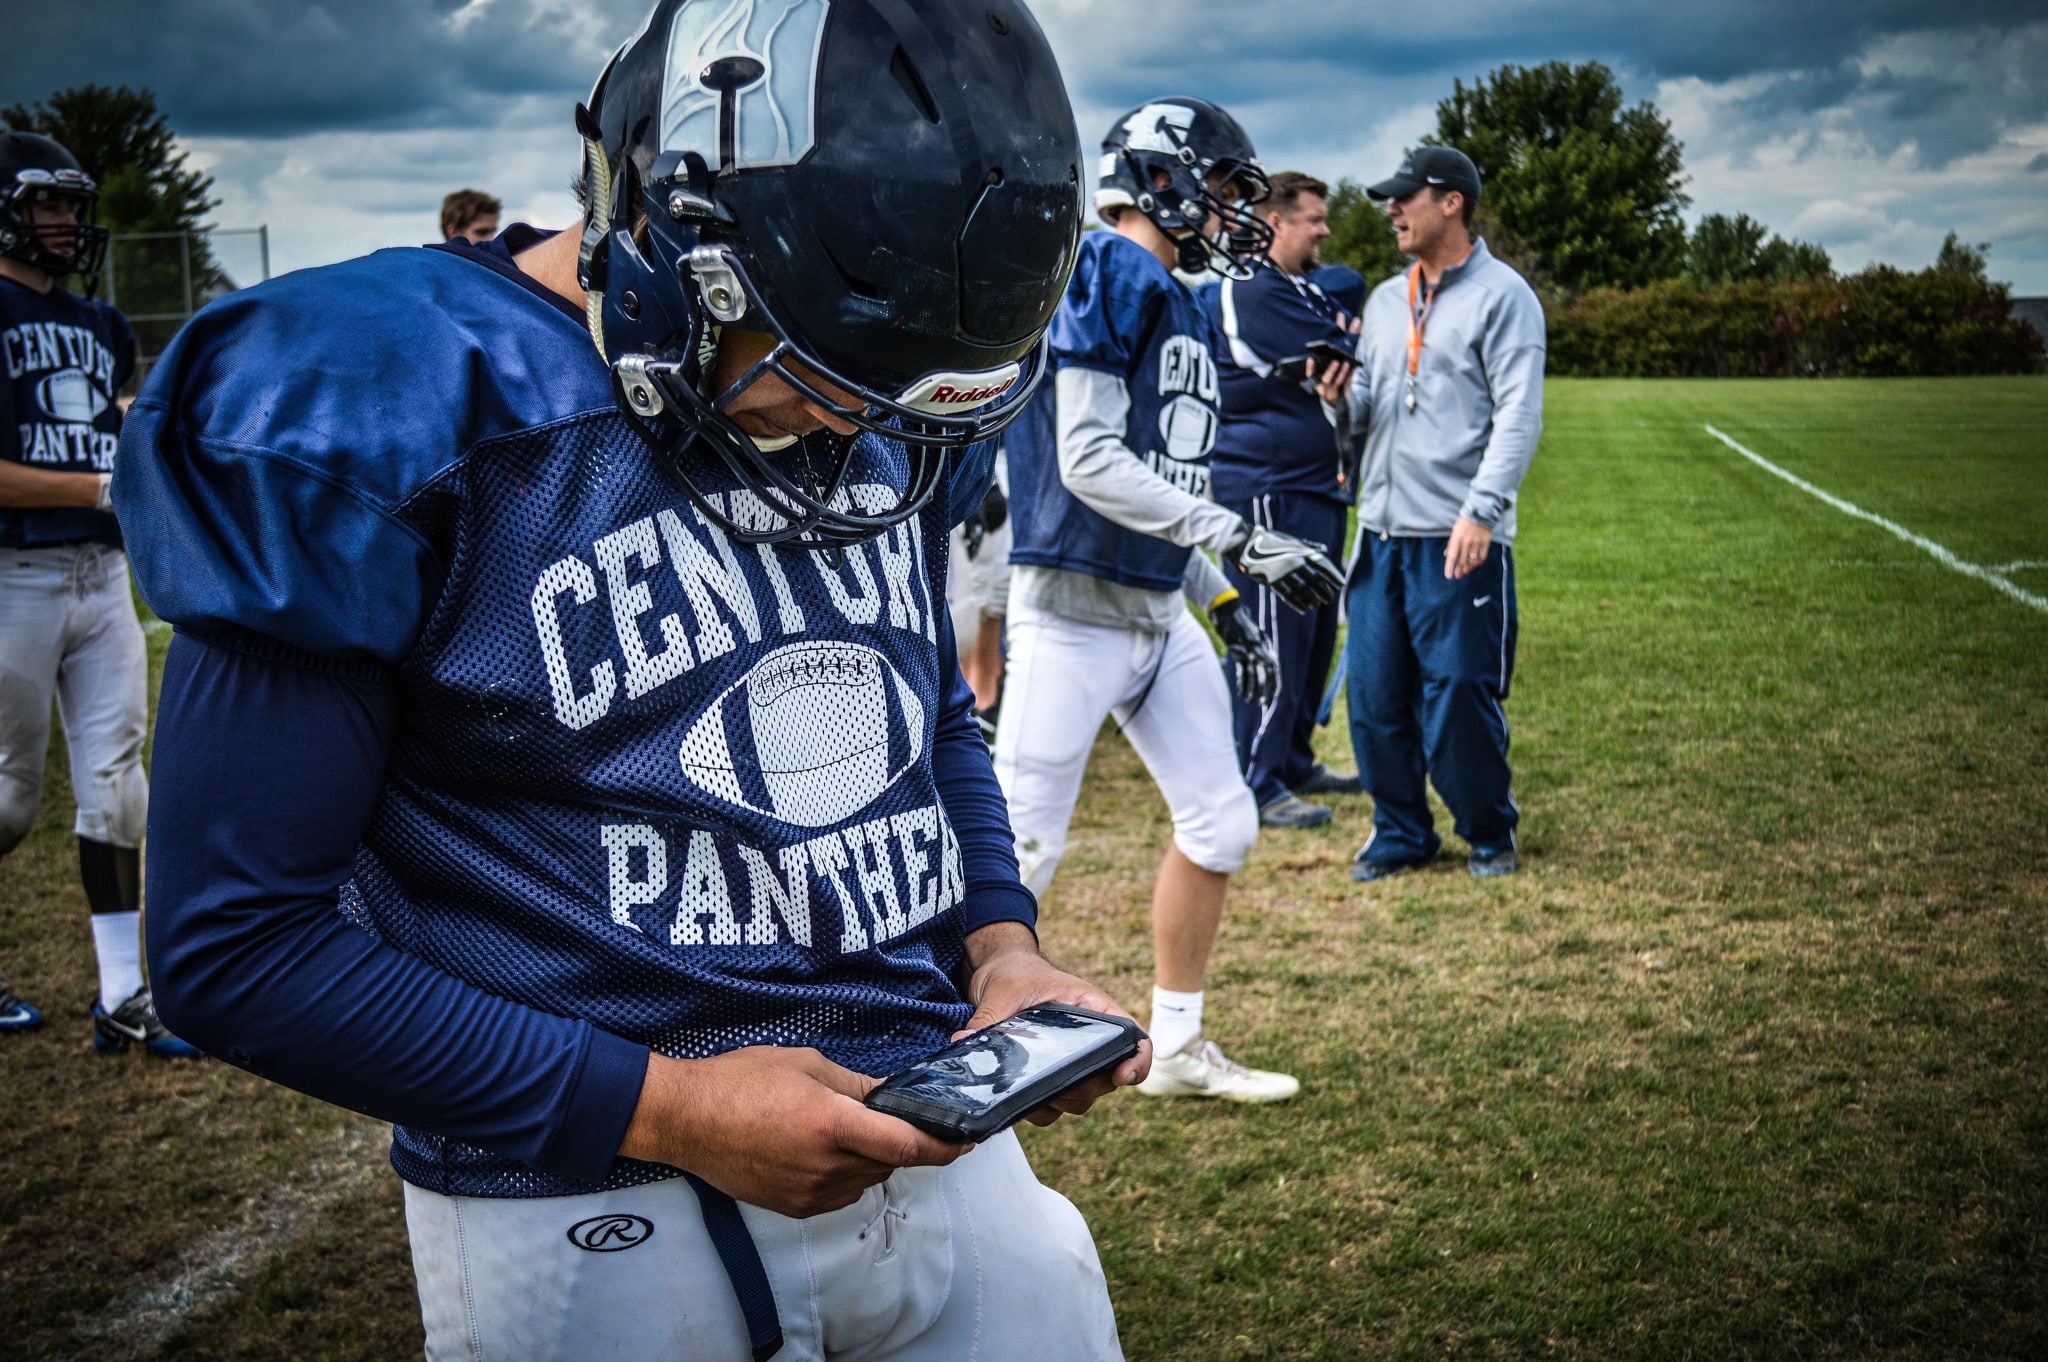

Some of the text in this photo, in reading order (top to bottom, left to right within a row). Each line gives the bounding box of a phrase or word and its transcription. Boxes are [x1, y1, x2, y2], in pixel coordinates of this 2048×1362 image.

[928, 373, 1017, 403] Riddell
[531, 483, 937, 730] CENTUR
[600, 800, 965, 954] PANTHER
